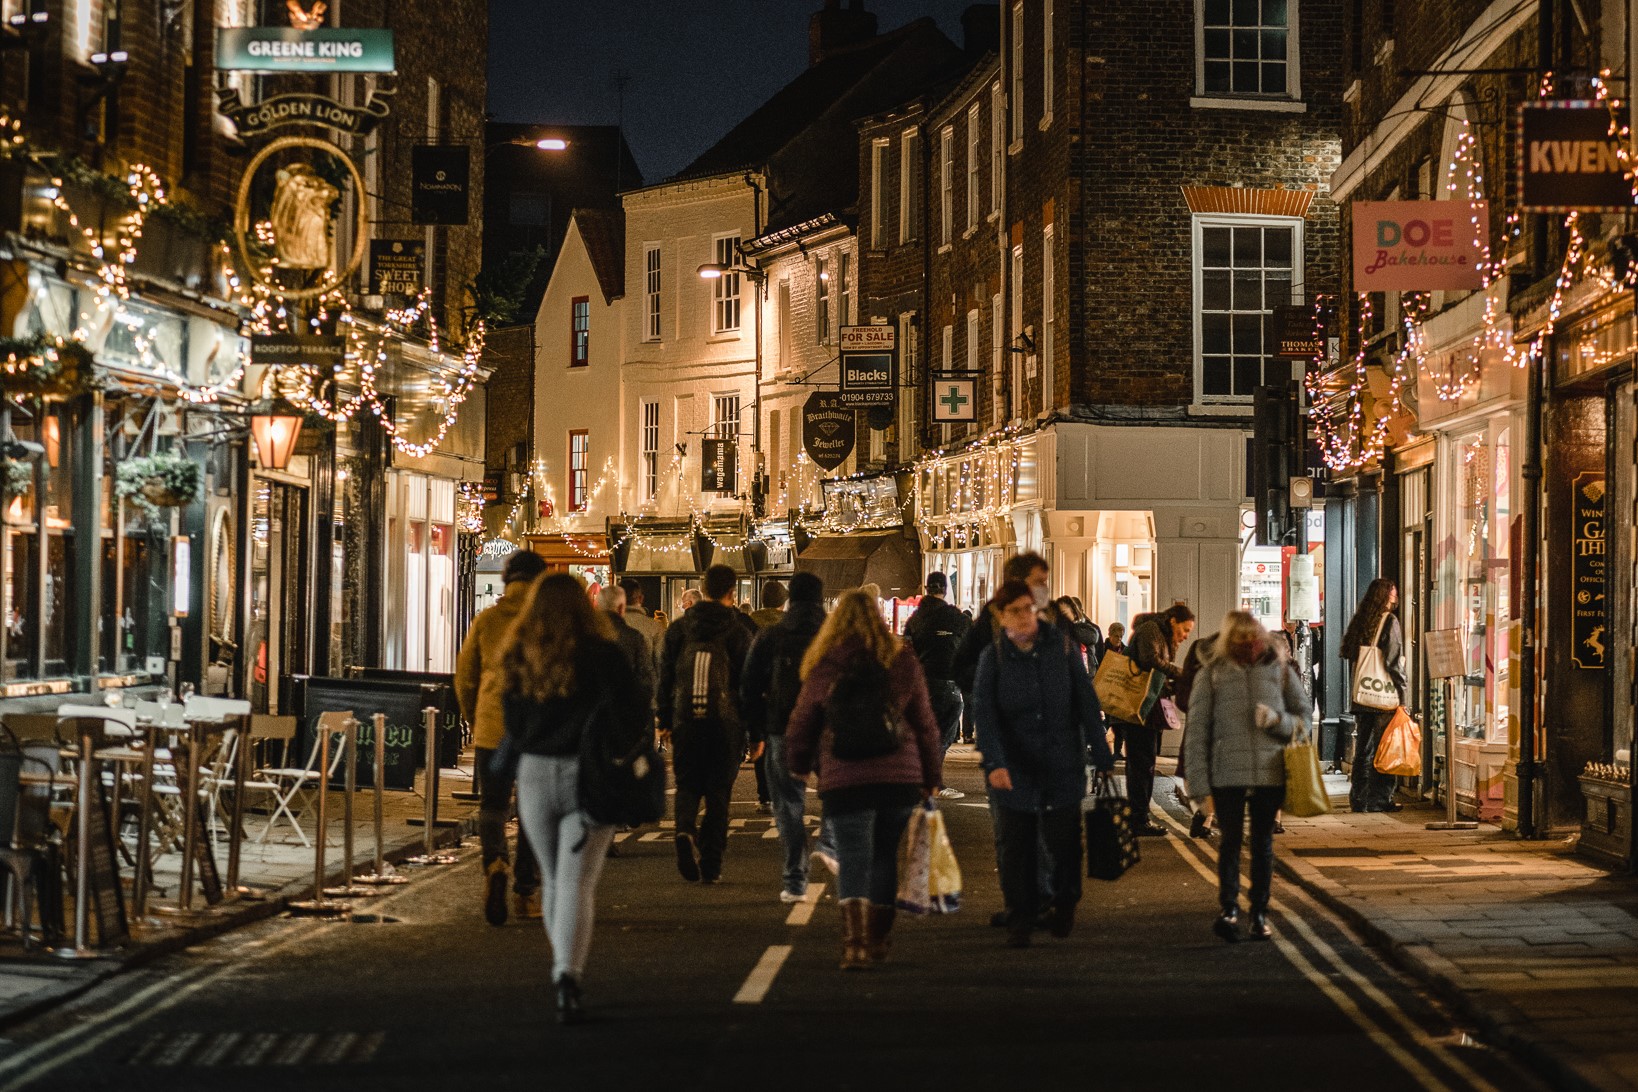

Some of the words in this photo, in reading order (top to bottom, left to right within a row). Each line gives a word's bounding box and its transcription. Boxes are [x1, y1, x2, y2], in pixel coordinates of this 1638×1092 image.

[248, 41, 314, 57] GREENE
[319, 42, 362, 57] KING
[248, 102, 311, 125] GOLDEN
[317, 105, 354, 126] LION
[1376, 219, 1454, 247] DOE
[1364, 250, 1467, 275] Bakehouse
[375, 270, 419, 281] SWEET
[380, 281, 414, 294] SHOP
[841, 333, 863, 342] FOR
[866, 332, 894, 341] SALE
[255, 345, 299, 353] ROOFTOP
[302, 346, 342, 354] TERRACE
[847, 369, 888, 381] Blacks
[866, 392, 894, 401] 679733
[806, 410, 852, 424] Braithwaite
[812, 437, 845, 449] Jeweller
[716, 442, 725, 489] wagamama
[1576, 609, 1595, 617] FIRST
